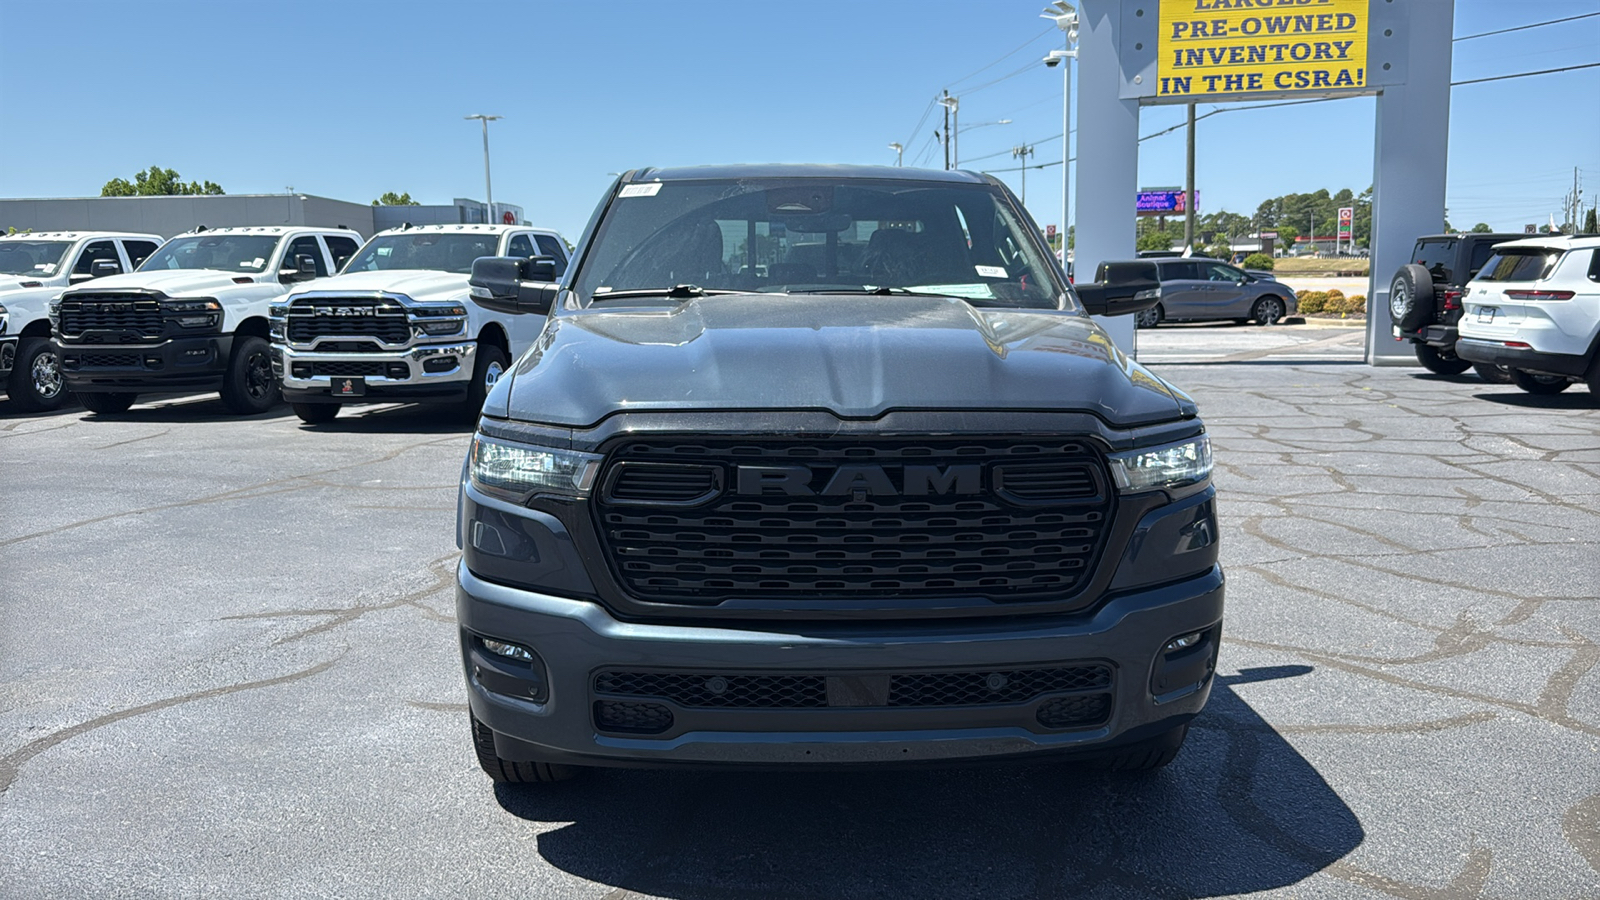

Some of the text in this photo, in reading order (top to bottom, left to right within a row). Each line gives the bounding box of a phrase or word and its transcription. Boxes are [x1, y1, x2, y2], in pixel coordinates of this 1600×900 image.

[1171, 13, 1357, 39] PRE-OWNED
[1173, 41, 1354, 66] INVENTORY
[1160, 68, 1363, 94] IN THE CSRA!
[315, 306, 374, 316] RAM
[737, 464, 981, 496] RAM
